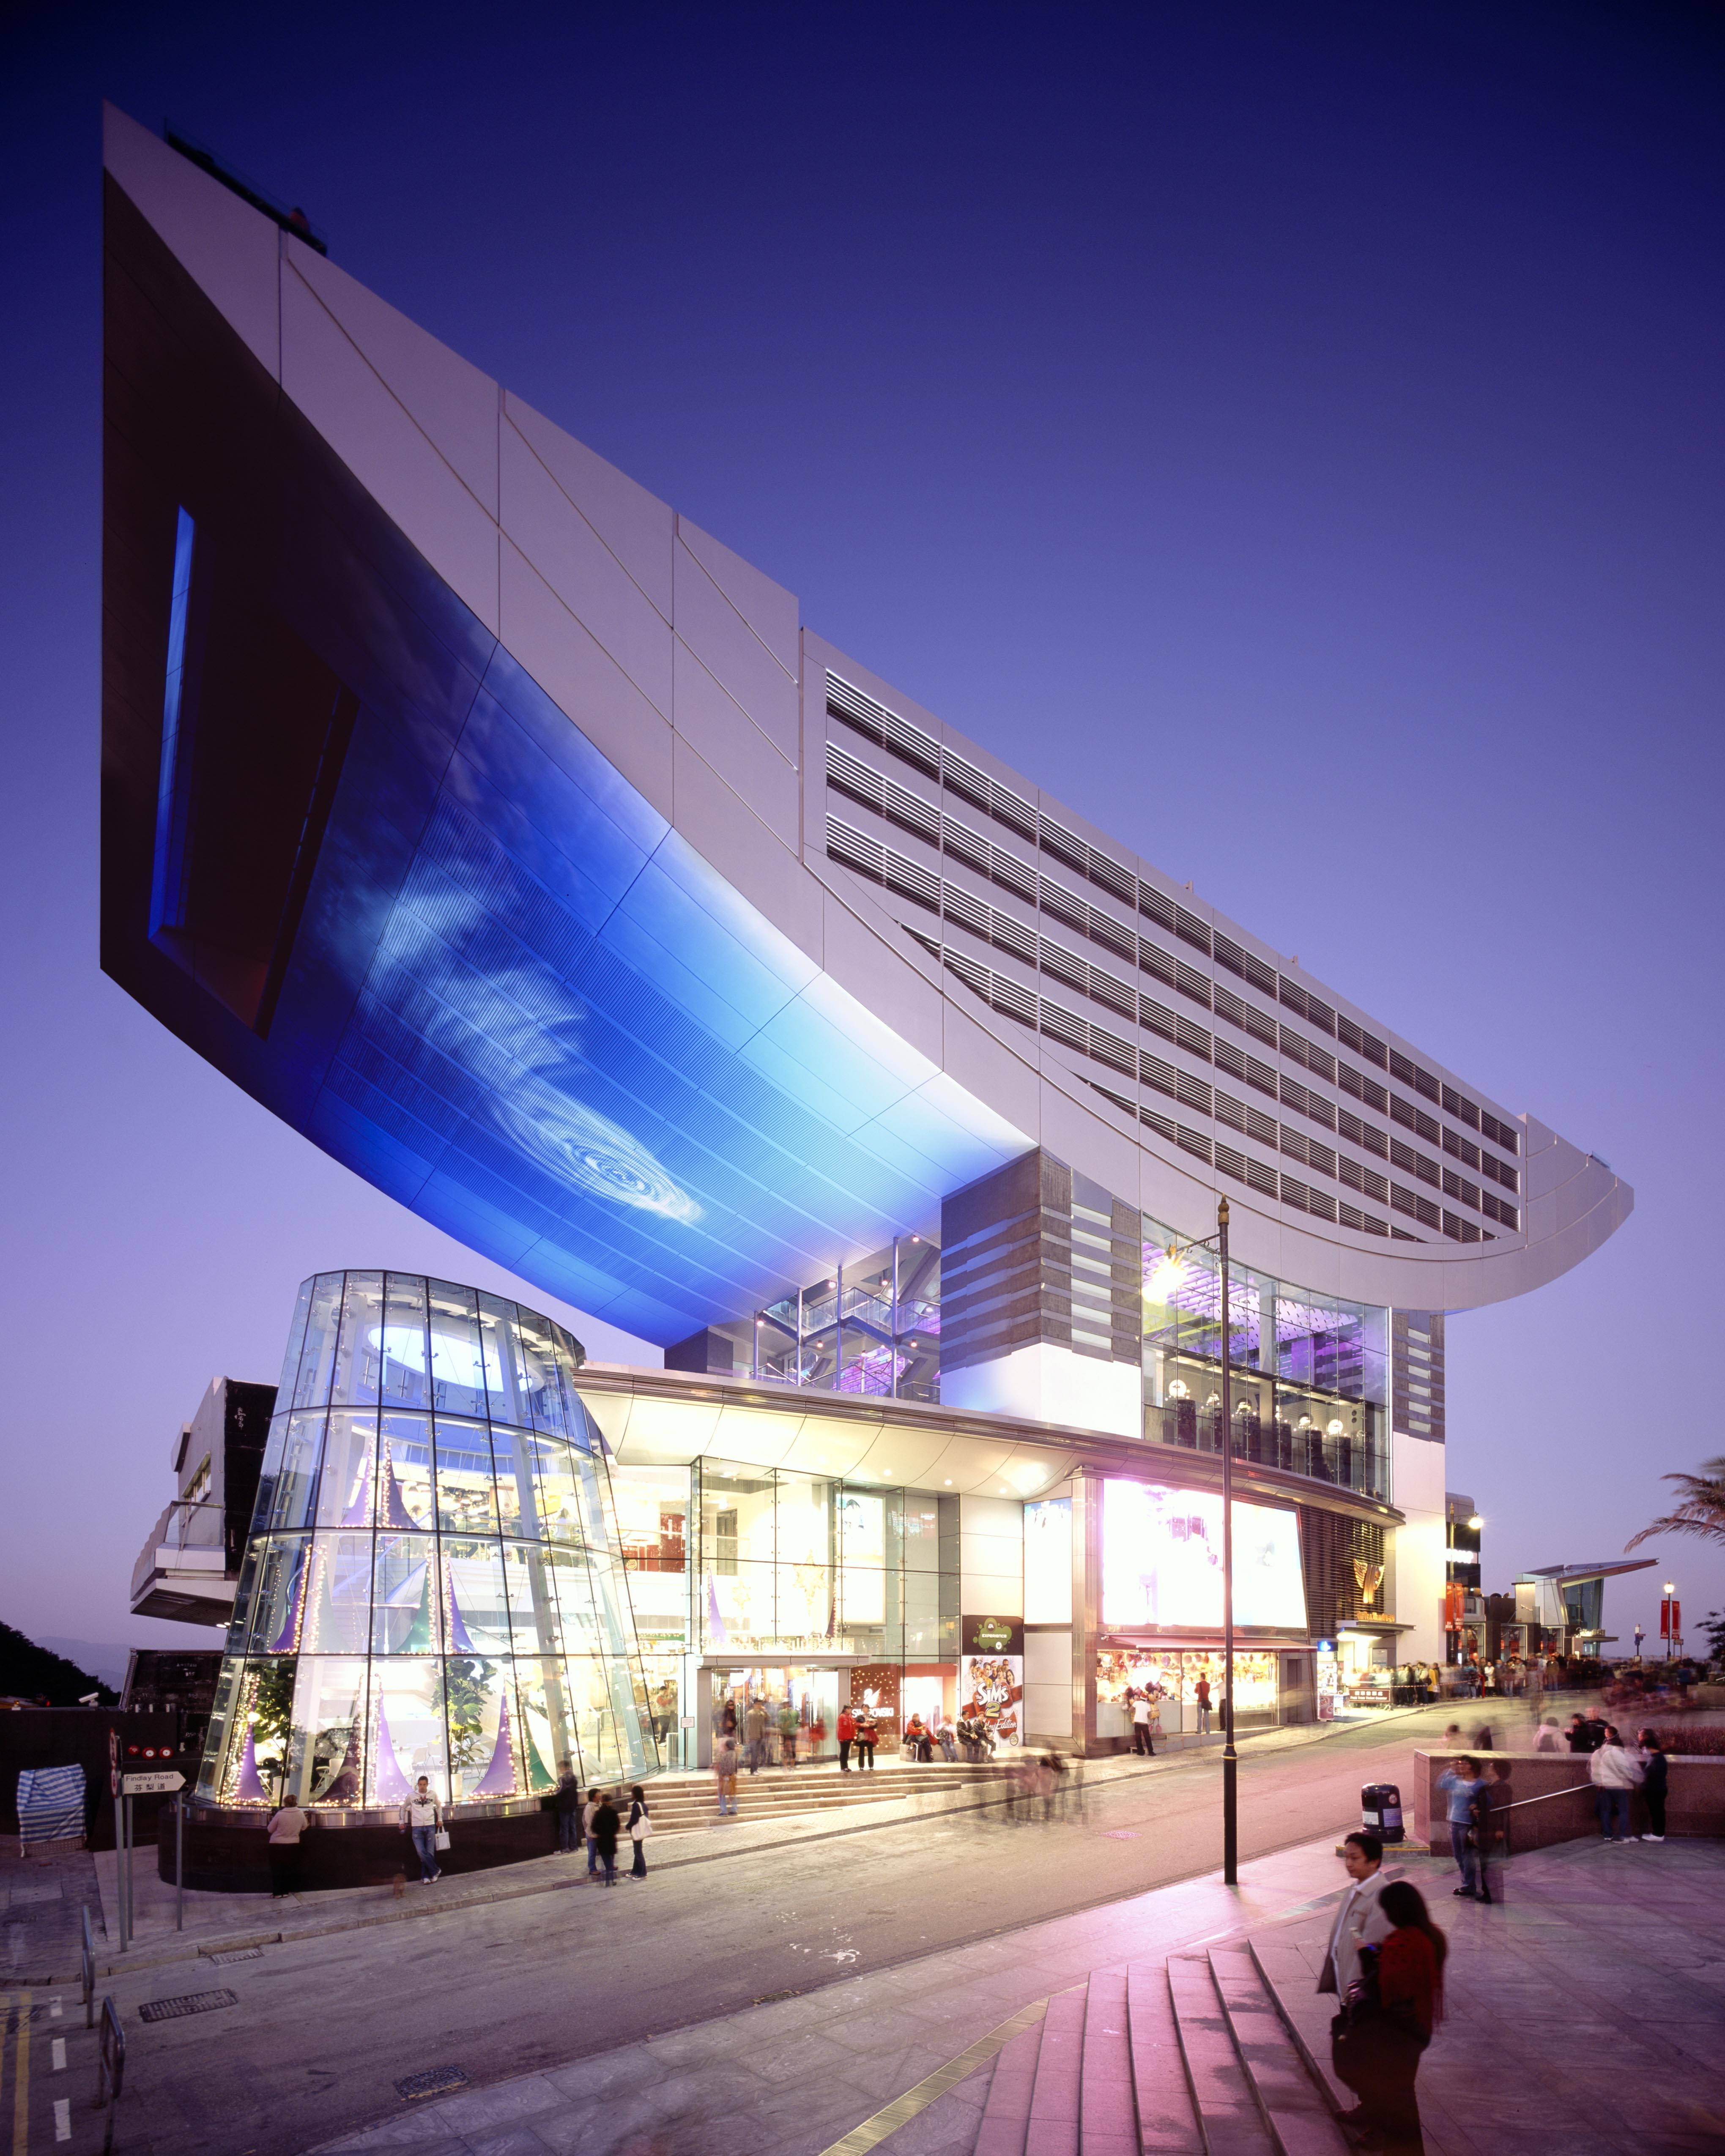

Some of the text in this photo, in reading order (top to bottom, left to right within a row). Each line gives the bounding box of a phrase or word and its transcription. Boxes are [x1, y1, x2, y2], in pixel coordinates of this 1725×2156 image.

[986, 1701, 1001, 1718] 2
[996, 1718, 1017, 1730] Edition
[134, 1783, 165, 1792] 芬梨道
